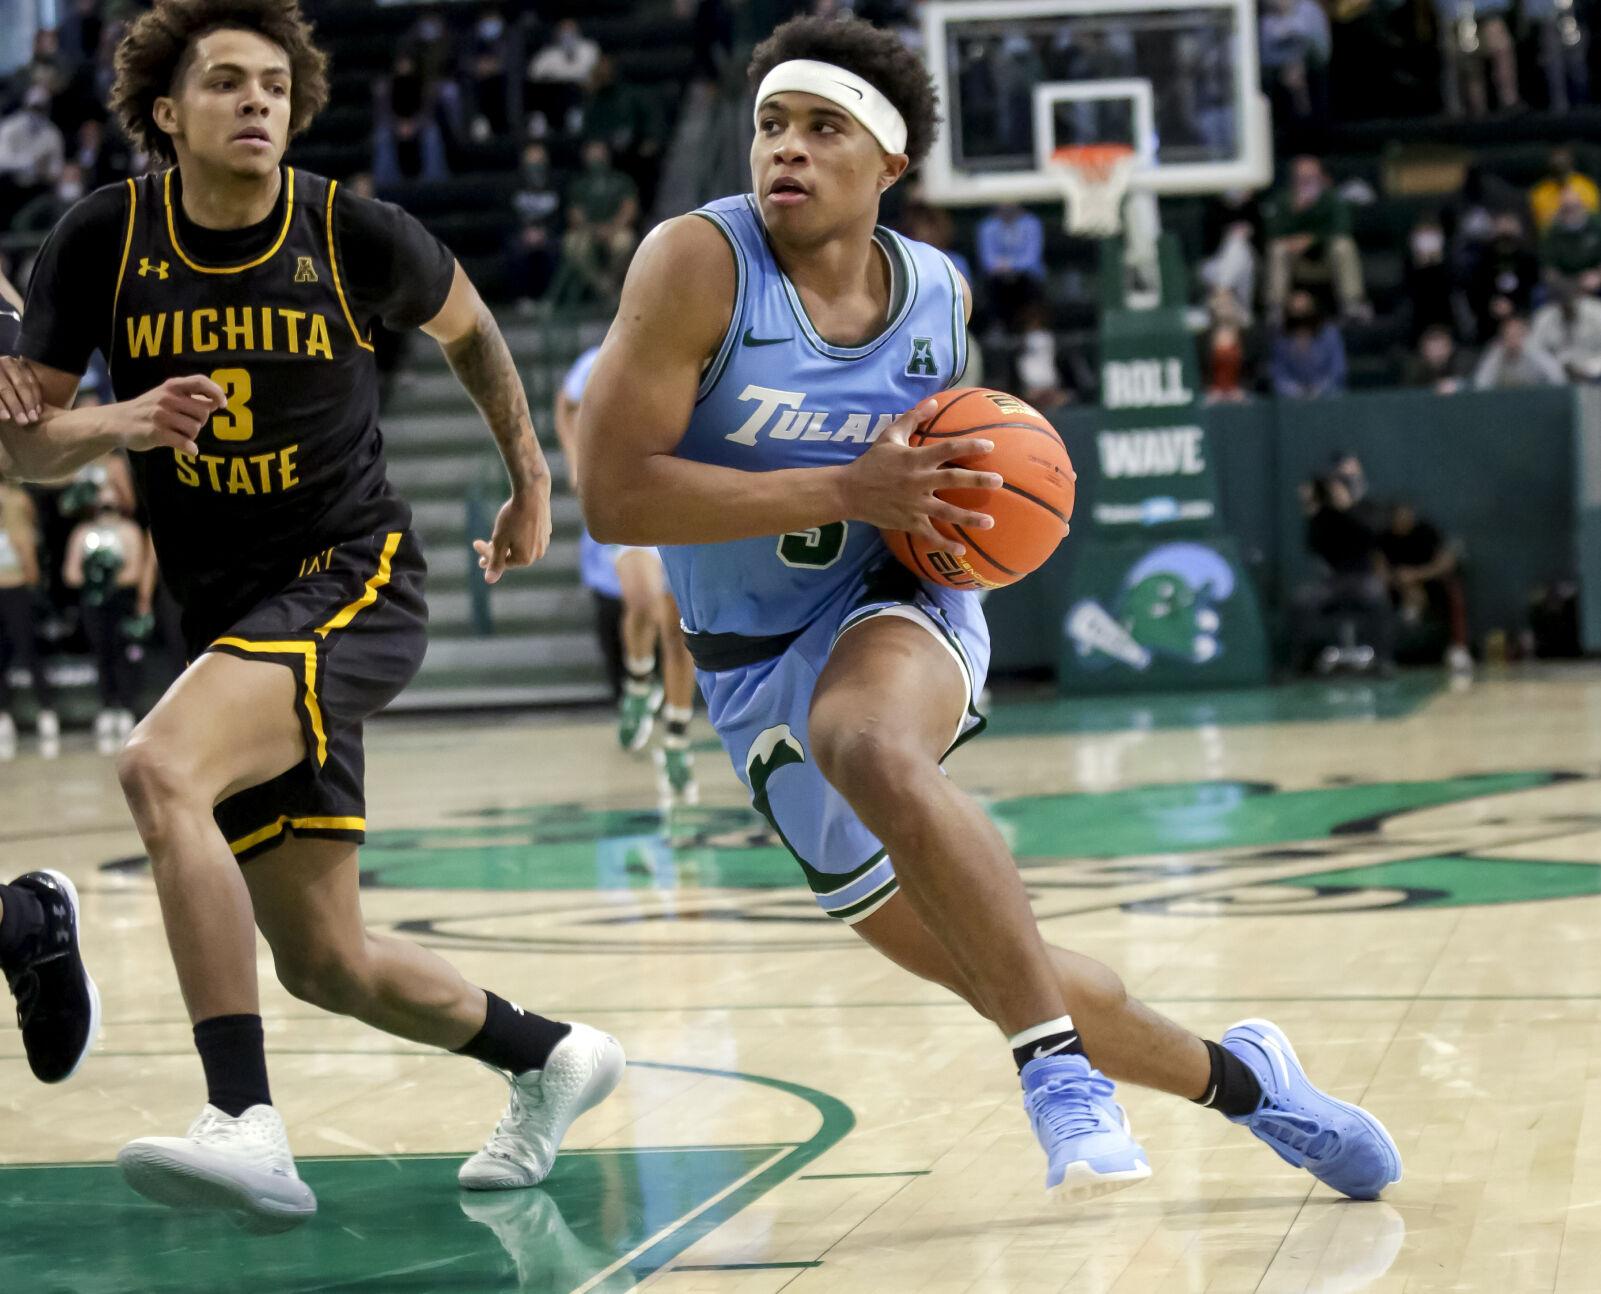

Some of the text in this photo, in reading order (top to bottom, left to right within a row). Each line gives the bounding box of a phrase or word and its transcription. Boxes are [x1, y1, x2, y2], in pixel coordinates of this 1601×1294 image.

[126, 306, 334, 360] WICHITA
[209, 368, 254, 442] 3
[1102, 357, 1193, 409] ROLL
[173, 444, 300, 495] STATE
[1098, 425, 1205, 478] WAVE
